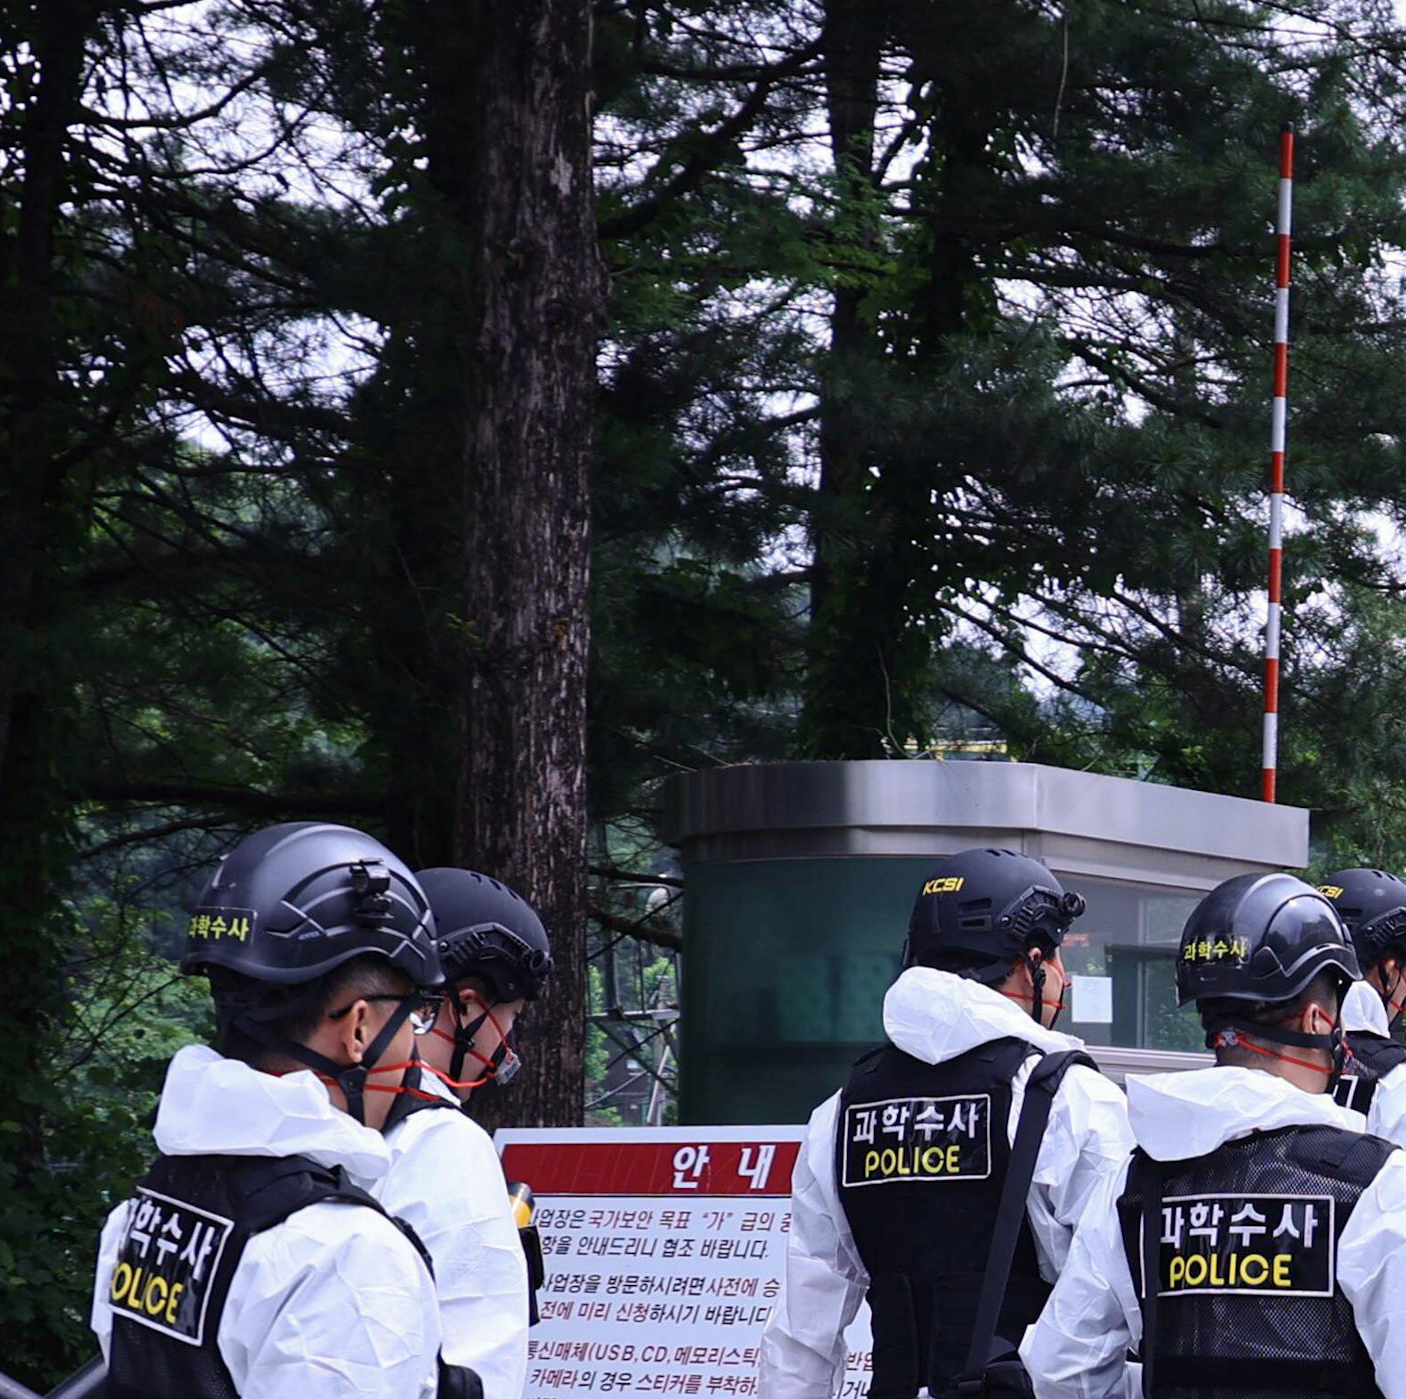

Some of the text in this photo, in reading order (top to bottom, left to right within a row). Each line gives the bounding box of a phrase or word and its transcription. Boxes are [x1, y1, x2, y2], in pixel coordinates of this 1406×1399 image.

[922, 877, 965, 897] KCSI
[1317, 885, 1344, 899] CSI
[1183, 936, 1247, 961] 과학수사
[852, 1101, 980, 1144] 과학수사
[865, 1144, 961, 1178] POLICE
[659, 1210, 692, 1229] 목표
[740, 1212, 776, 1232] 급의
[1160, 1202, 1320, 1249] 과학수사
[576, 1236, 658, 1257] 안내드리니
[661, 1238, 695, 1258] 협조
[700, 1239, 769, 1260] 바랍니다.
[1169, 1253, 1292, 1288] POLICE
[578, 1302, 612, 1321] 미리
[616, 1303, 700, 1324] 신청하시기
[530, 1368, 597, 1391] 카메라의
[600, 1371, 633, 1392] 경우
[635, 1374, 702, 1395] 스티커를
